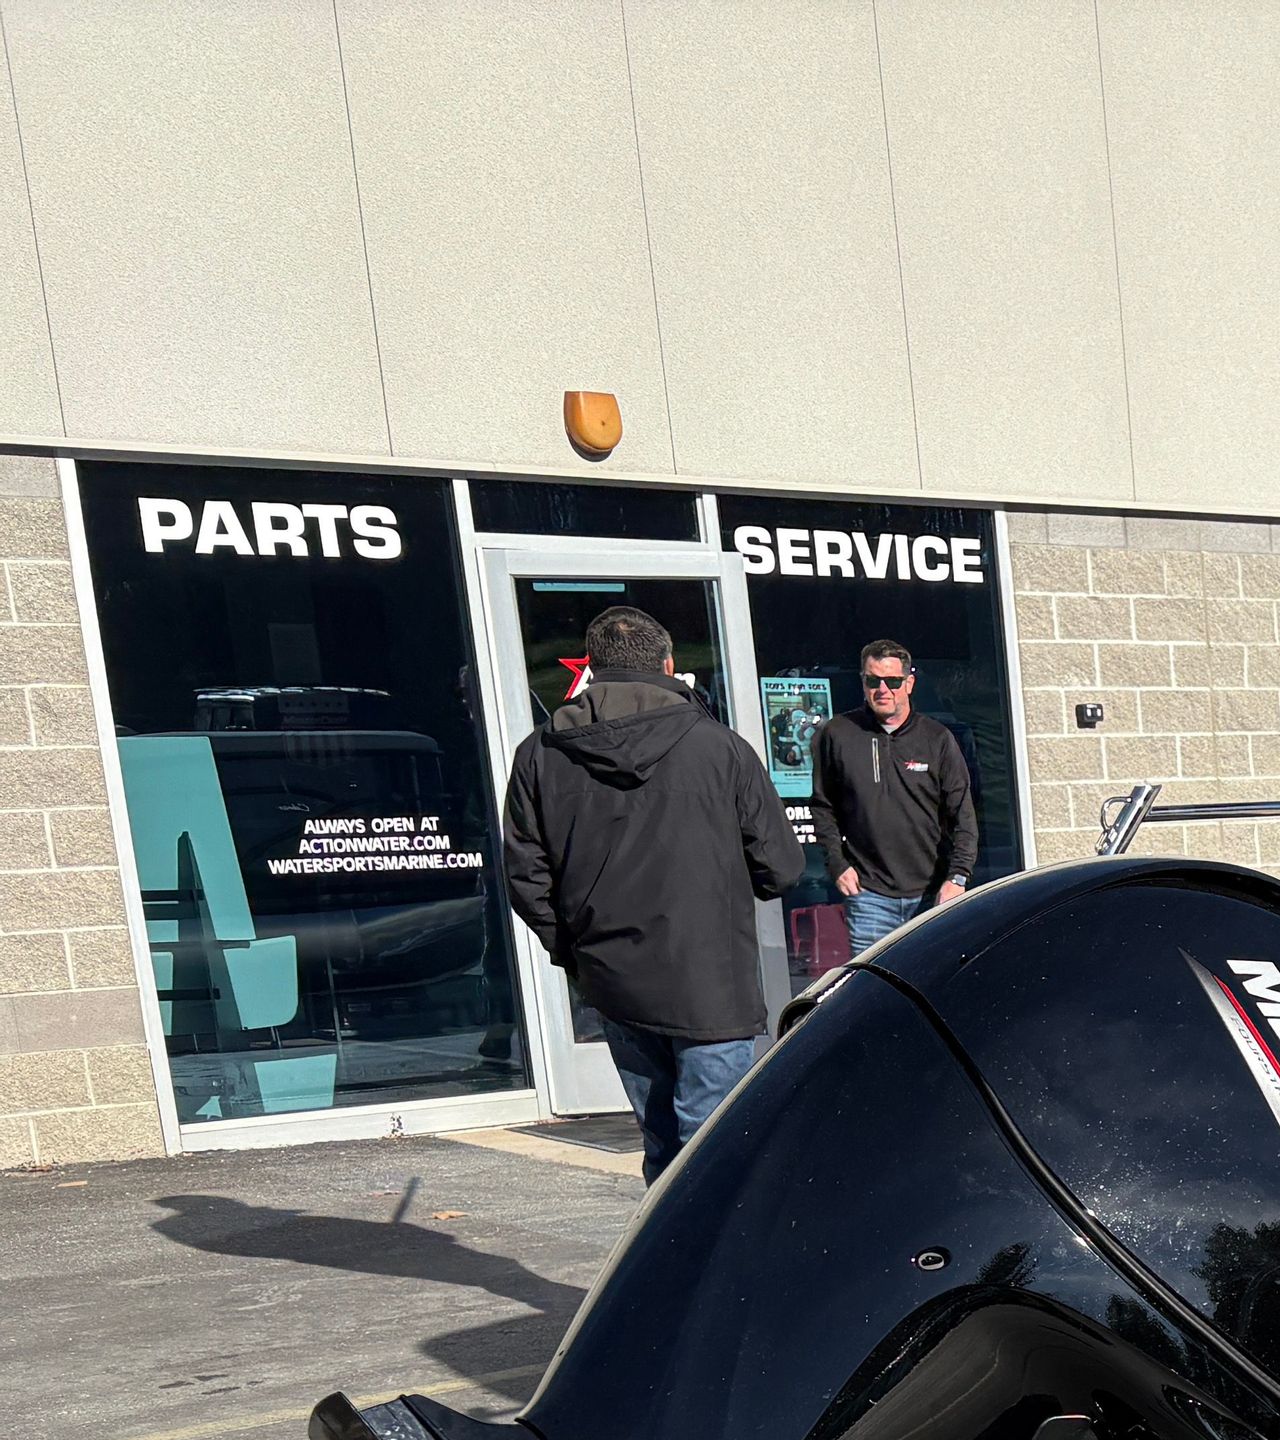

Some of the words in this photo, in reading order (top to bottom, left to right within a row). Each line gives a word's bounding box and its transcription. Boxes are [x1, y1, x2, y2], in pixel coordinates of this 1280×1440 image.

[138, 497, 401, 560] PARTS
[734, 525, 984, 583] SERVICE
[304, 819, 365, 834] ALWAYS
[371, 817, 415, 833] OPEN
[420, 816, 440, 831] AT
[298, 835, 451, 854] ACTIONWATER.COM
[267, 853, 483, 875] WATERSPORTSMARINE.COM
